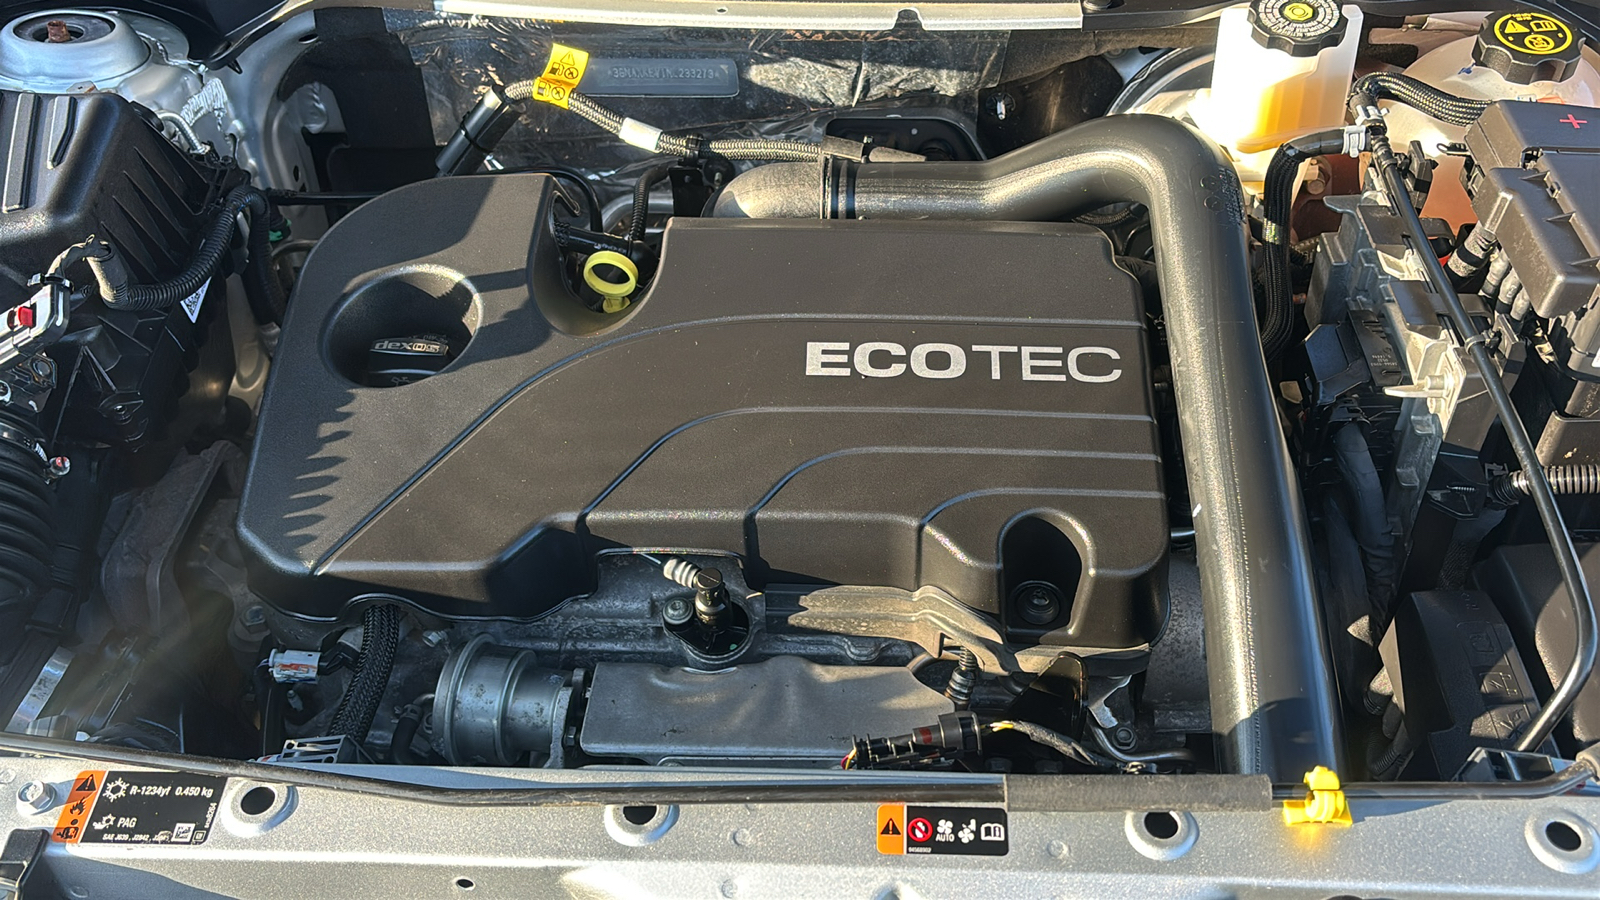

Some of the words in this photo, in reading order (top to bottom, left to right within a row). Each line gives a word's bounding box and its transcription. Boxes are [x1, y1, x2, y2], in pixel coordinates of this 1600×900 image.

[805, 341, 1122, 383] ECOTEC
[129, 785, 172, 798] R-1234yf
[175, 786, 201, 797] 0.450
[201, 786, 214, 798] kg
[117, 816, 138, 828] PAG
[935, 833, 955, 842] AUTO
